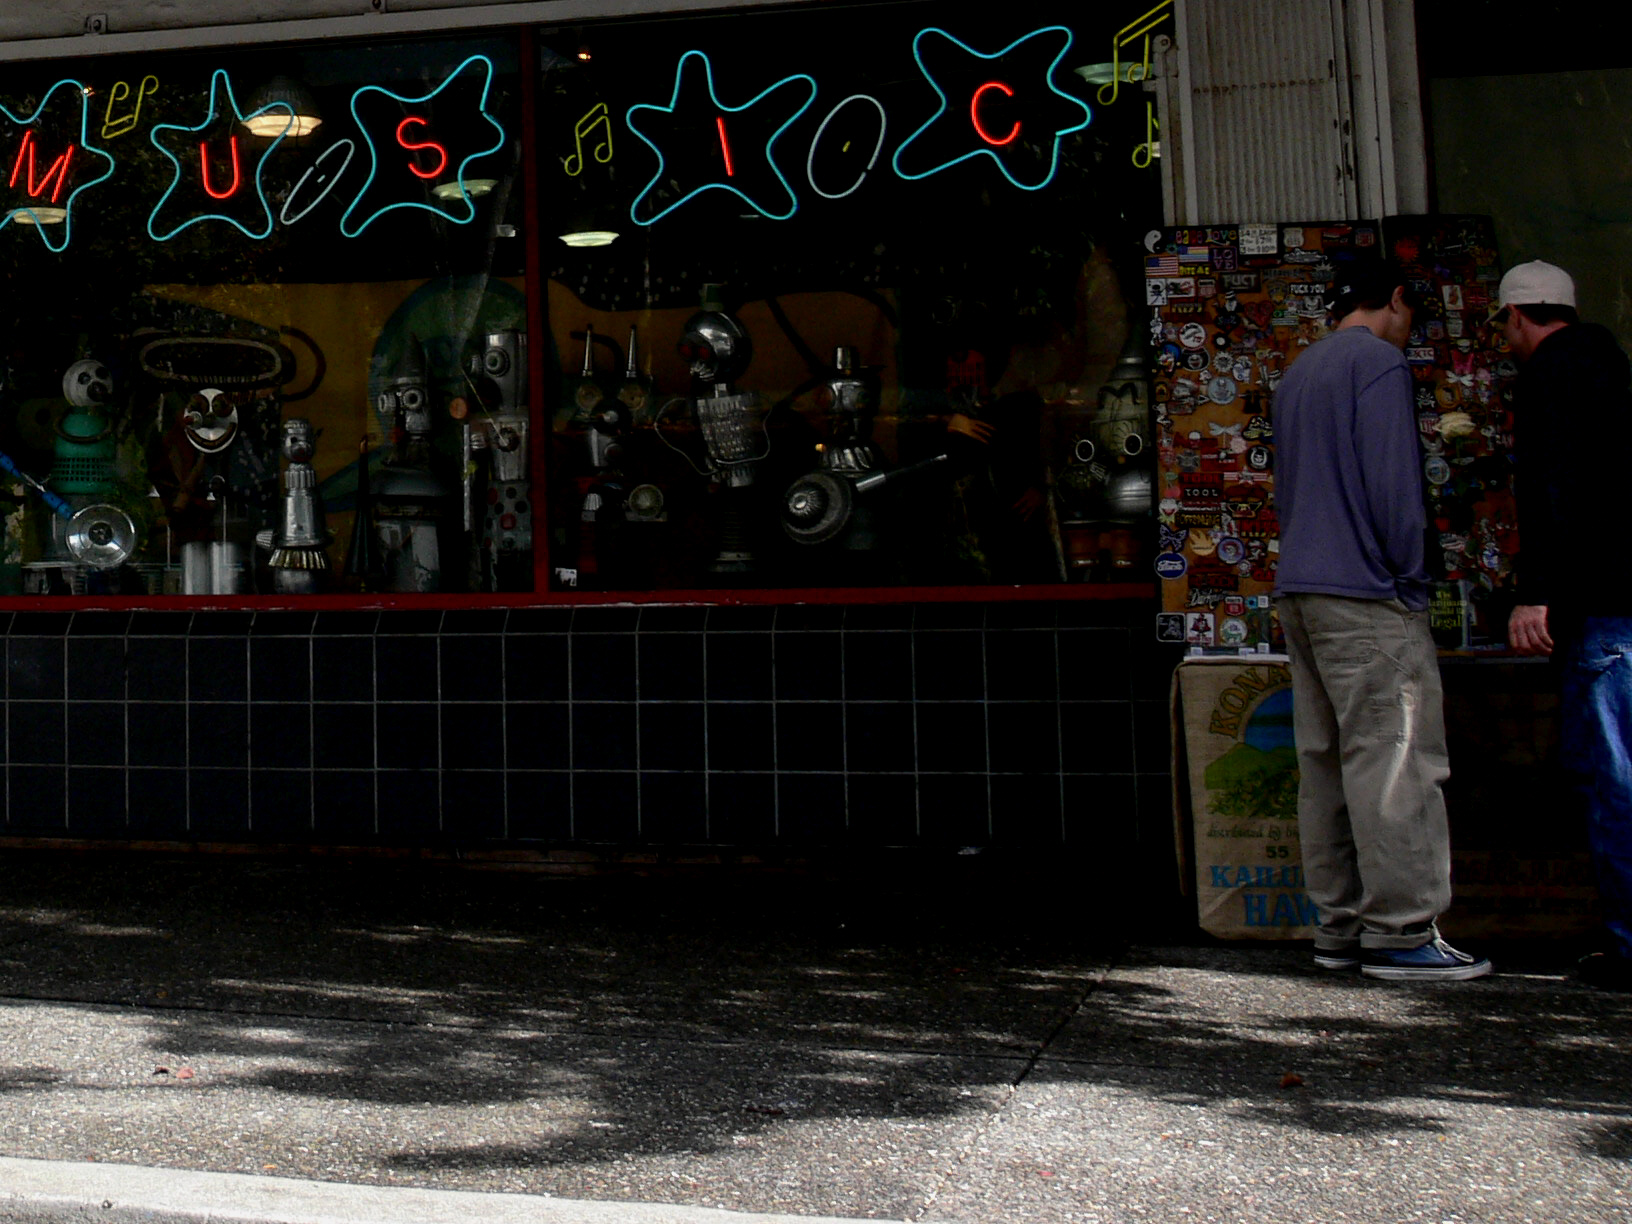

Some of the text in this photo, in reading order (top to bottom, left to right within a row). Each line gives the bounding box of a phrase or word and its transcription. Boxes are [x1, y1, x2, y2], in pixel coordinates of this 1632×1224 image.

[1184, 488, 1219, 497] TOOL
[1209, 664, 1291, 739] KONA
[1265, 845, 1289, 859] 55
[1210, 864, 1306, 889] KAILU
